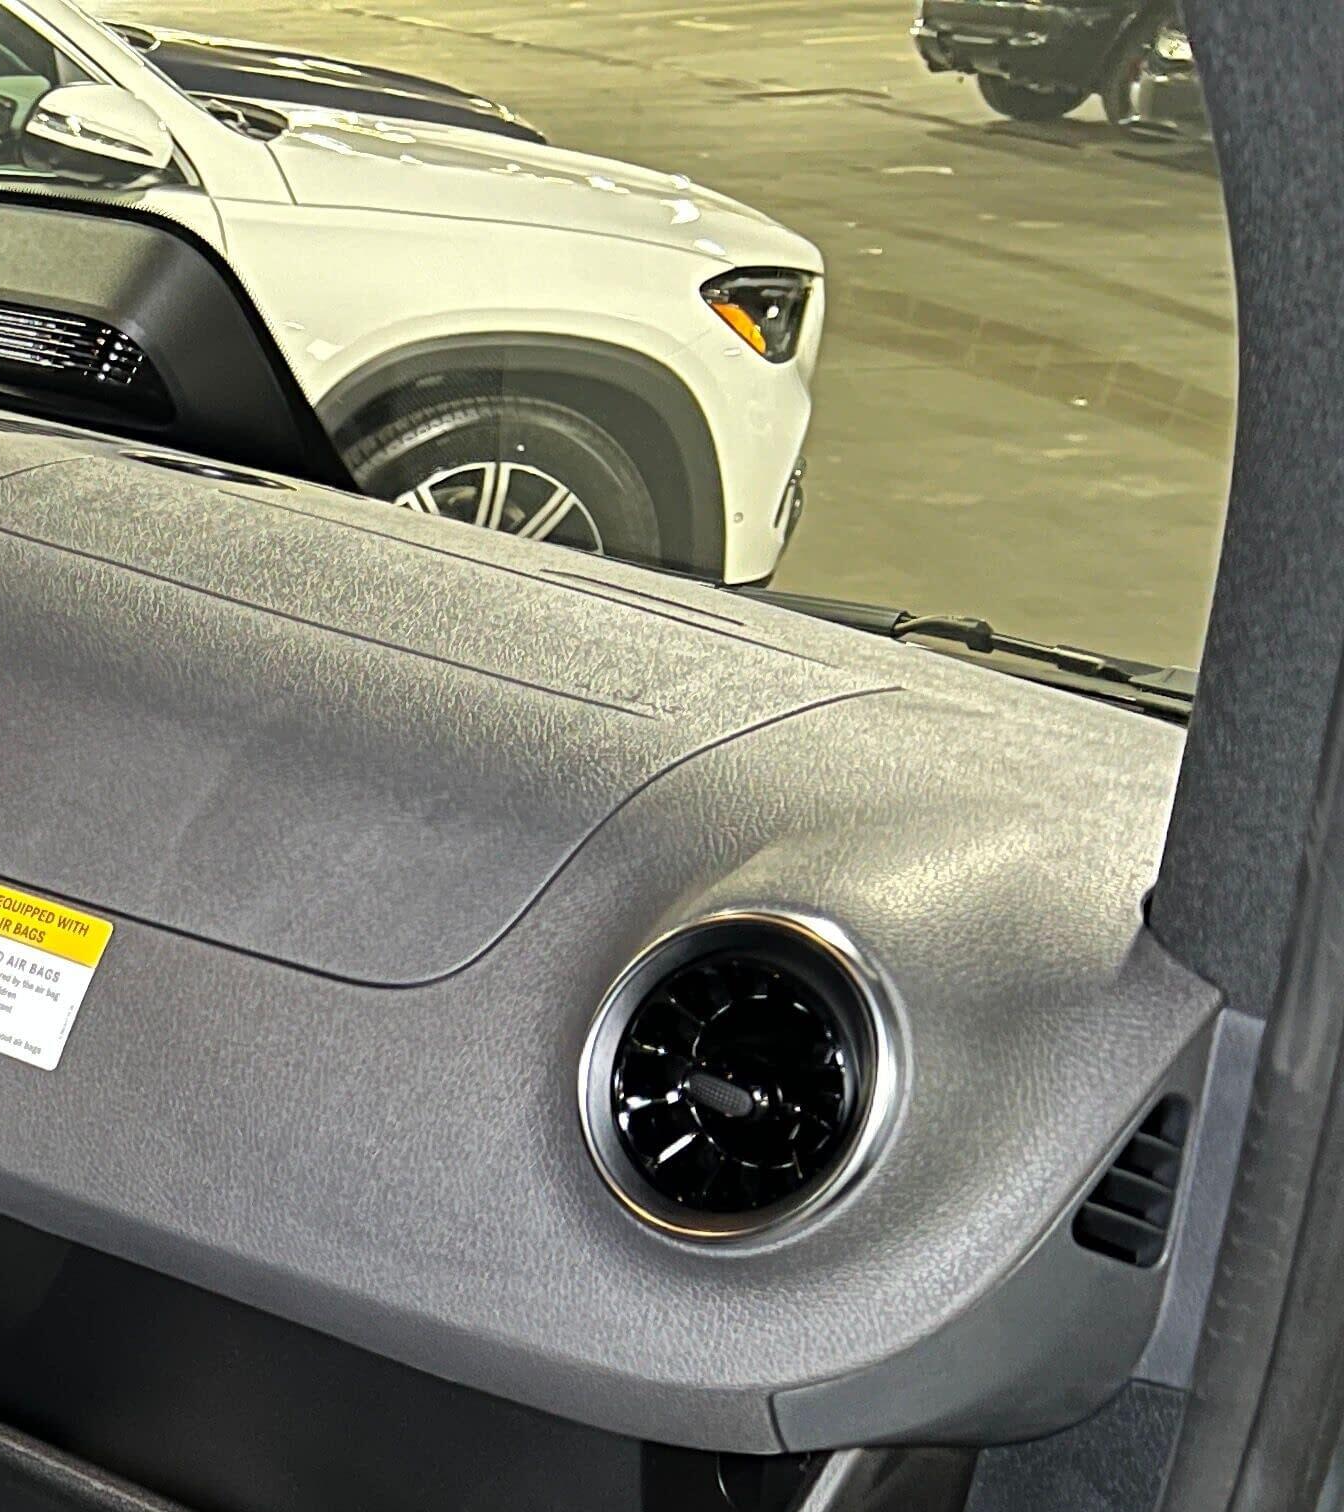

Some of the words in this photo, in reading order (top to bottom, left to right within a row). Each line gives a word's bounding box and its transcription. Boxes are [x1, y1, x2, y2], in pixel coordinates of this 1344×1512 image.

[12, 922, 46, 943] BAGS
[57, 915, 90, 937] WITH
[6, 955, 28, 972] AIR
[28, 963, 61, 983] BAGS
